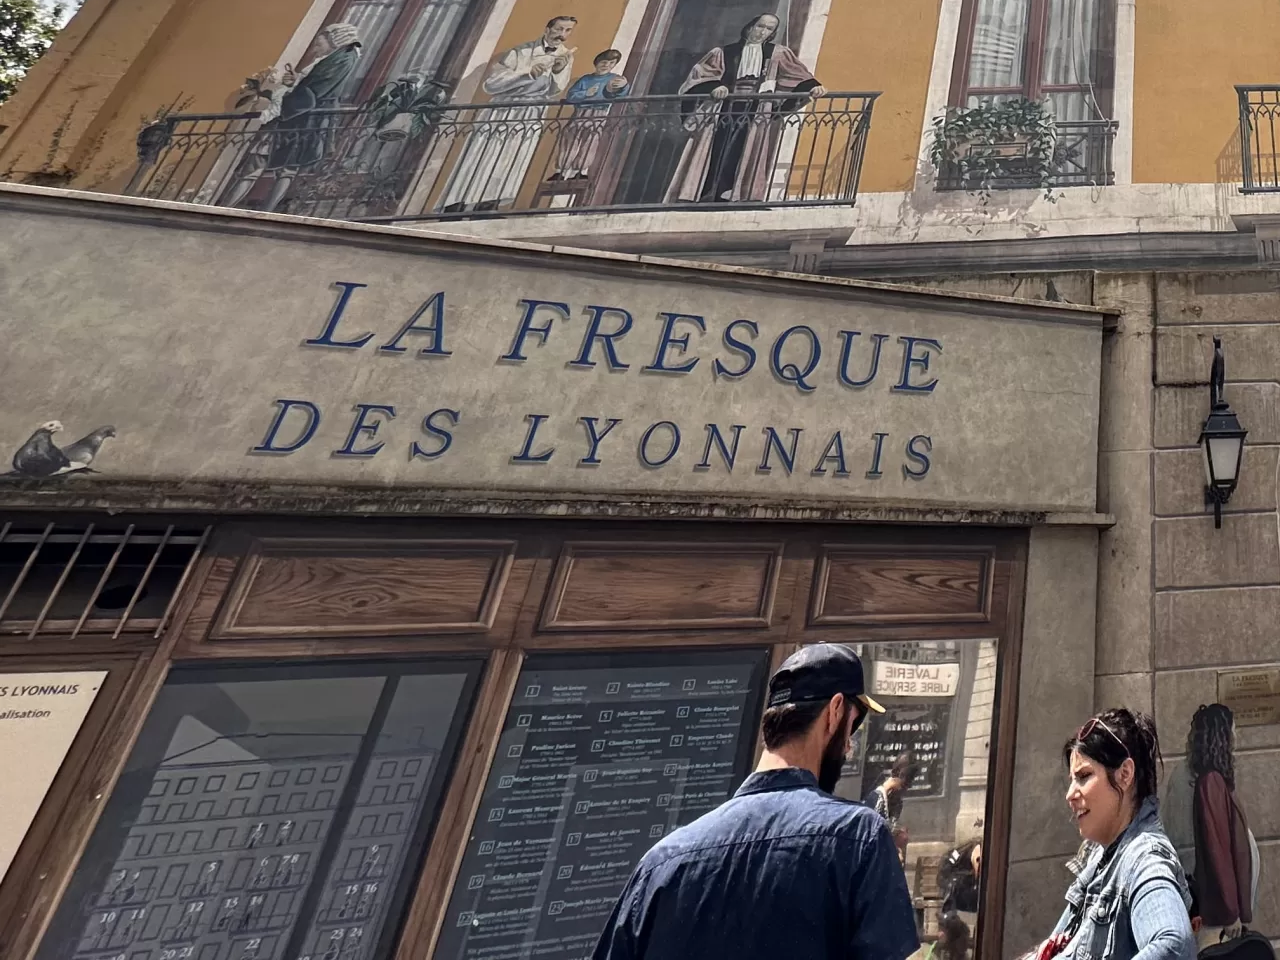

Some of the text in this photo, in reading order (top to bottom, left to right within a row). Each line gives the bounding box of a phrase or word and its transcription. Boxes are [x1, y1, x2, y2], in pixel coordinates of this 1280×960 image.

[306, 280, 944, 393] LA FRESQUE
[252, 398, 933, 479] DES LYONNAIS
[11, 684, 79, 697] LYONNAIS
[281, 820, 292, 830] 2
[206, 862, 218, 873] 5
[344, 884, 359, 895] 15
[364, 882, 379, 893] 16
[188, 901, 205, 913] 12
[100, 911, 117, 923] 10
[330, 928, 345, 940] 23
[244, 938, 261, 950] 22
[177, 946, 195, 958] 21
